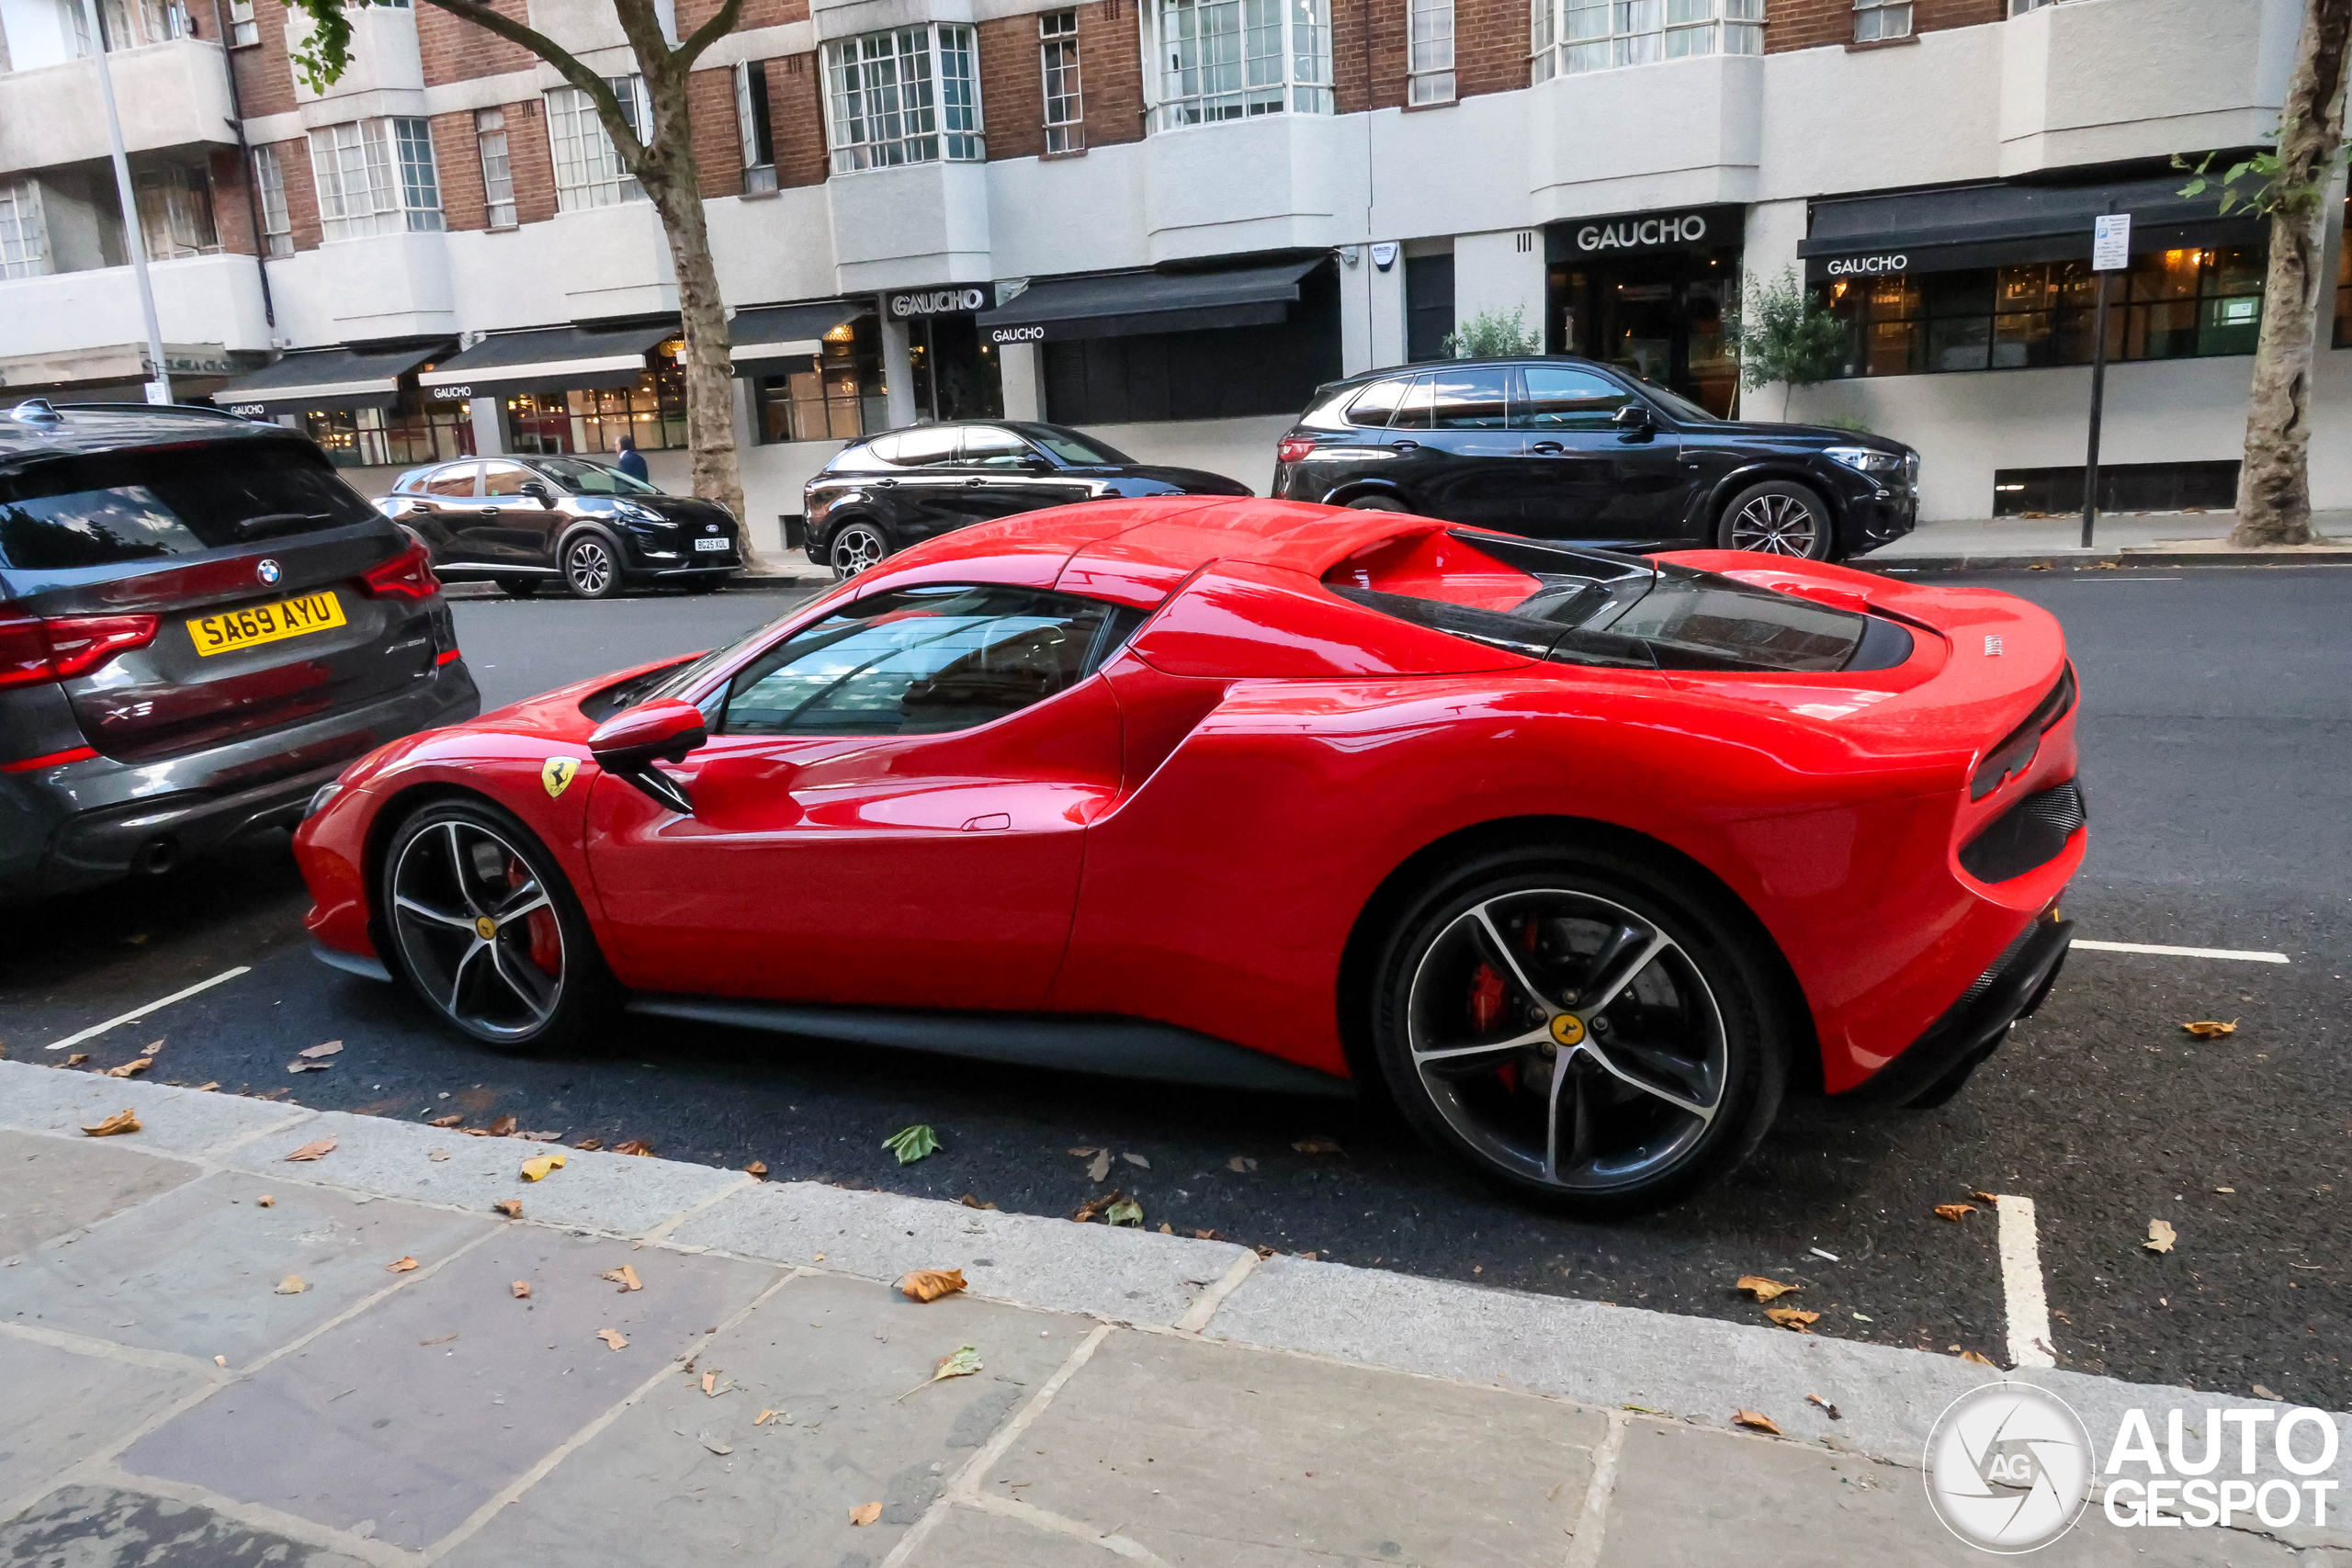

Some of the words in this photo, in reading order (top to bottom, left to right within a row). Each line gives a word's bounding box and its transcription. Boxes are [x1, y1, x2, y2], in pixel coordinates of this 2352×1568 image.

[1577, 215, 1706, 251] GAUCHO
[1827, 254, 1908, 275] GAUCHO
[892, 289, 984, 316] GAUCHO
[992, 326, 1045, 343] GAUCHO
[434, 386, 471, 399] GAUCHO
[231, 404, 265, 414] GAUCHO
[201, 608, 276, 645] SA69
[281, 597, 331, 629] AYU
[101, 701, 153, 725] X3
